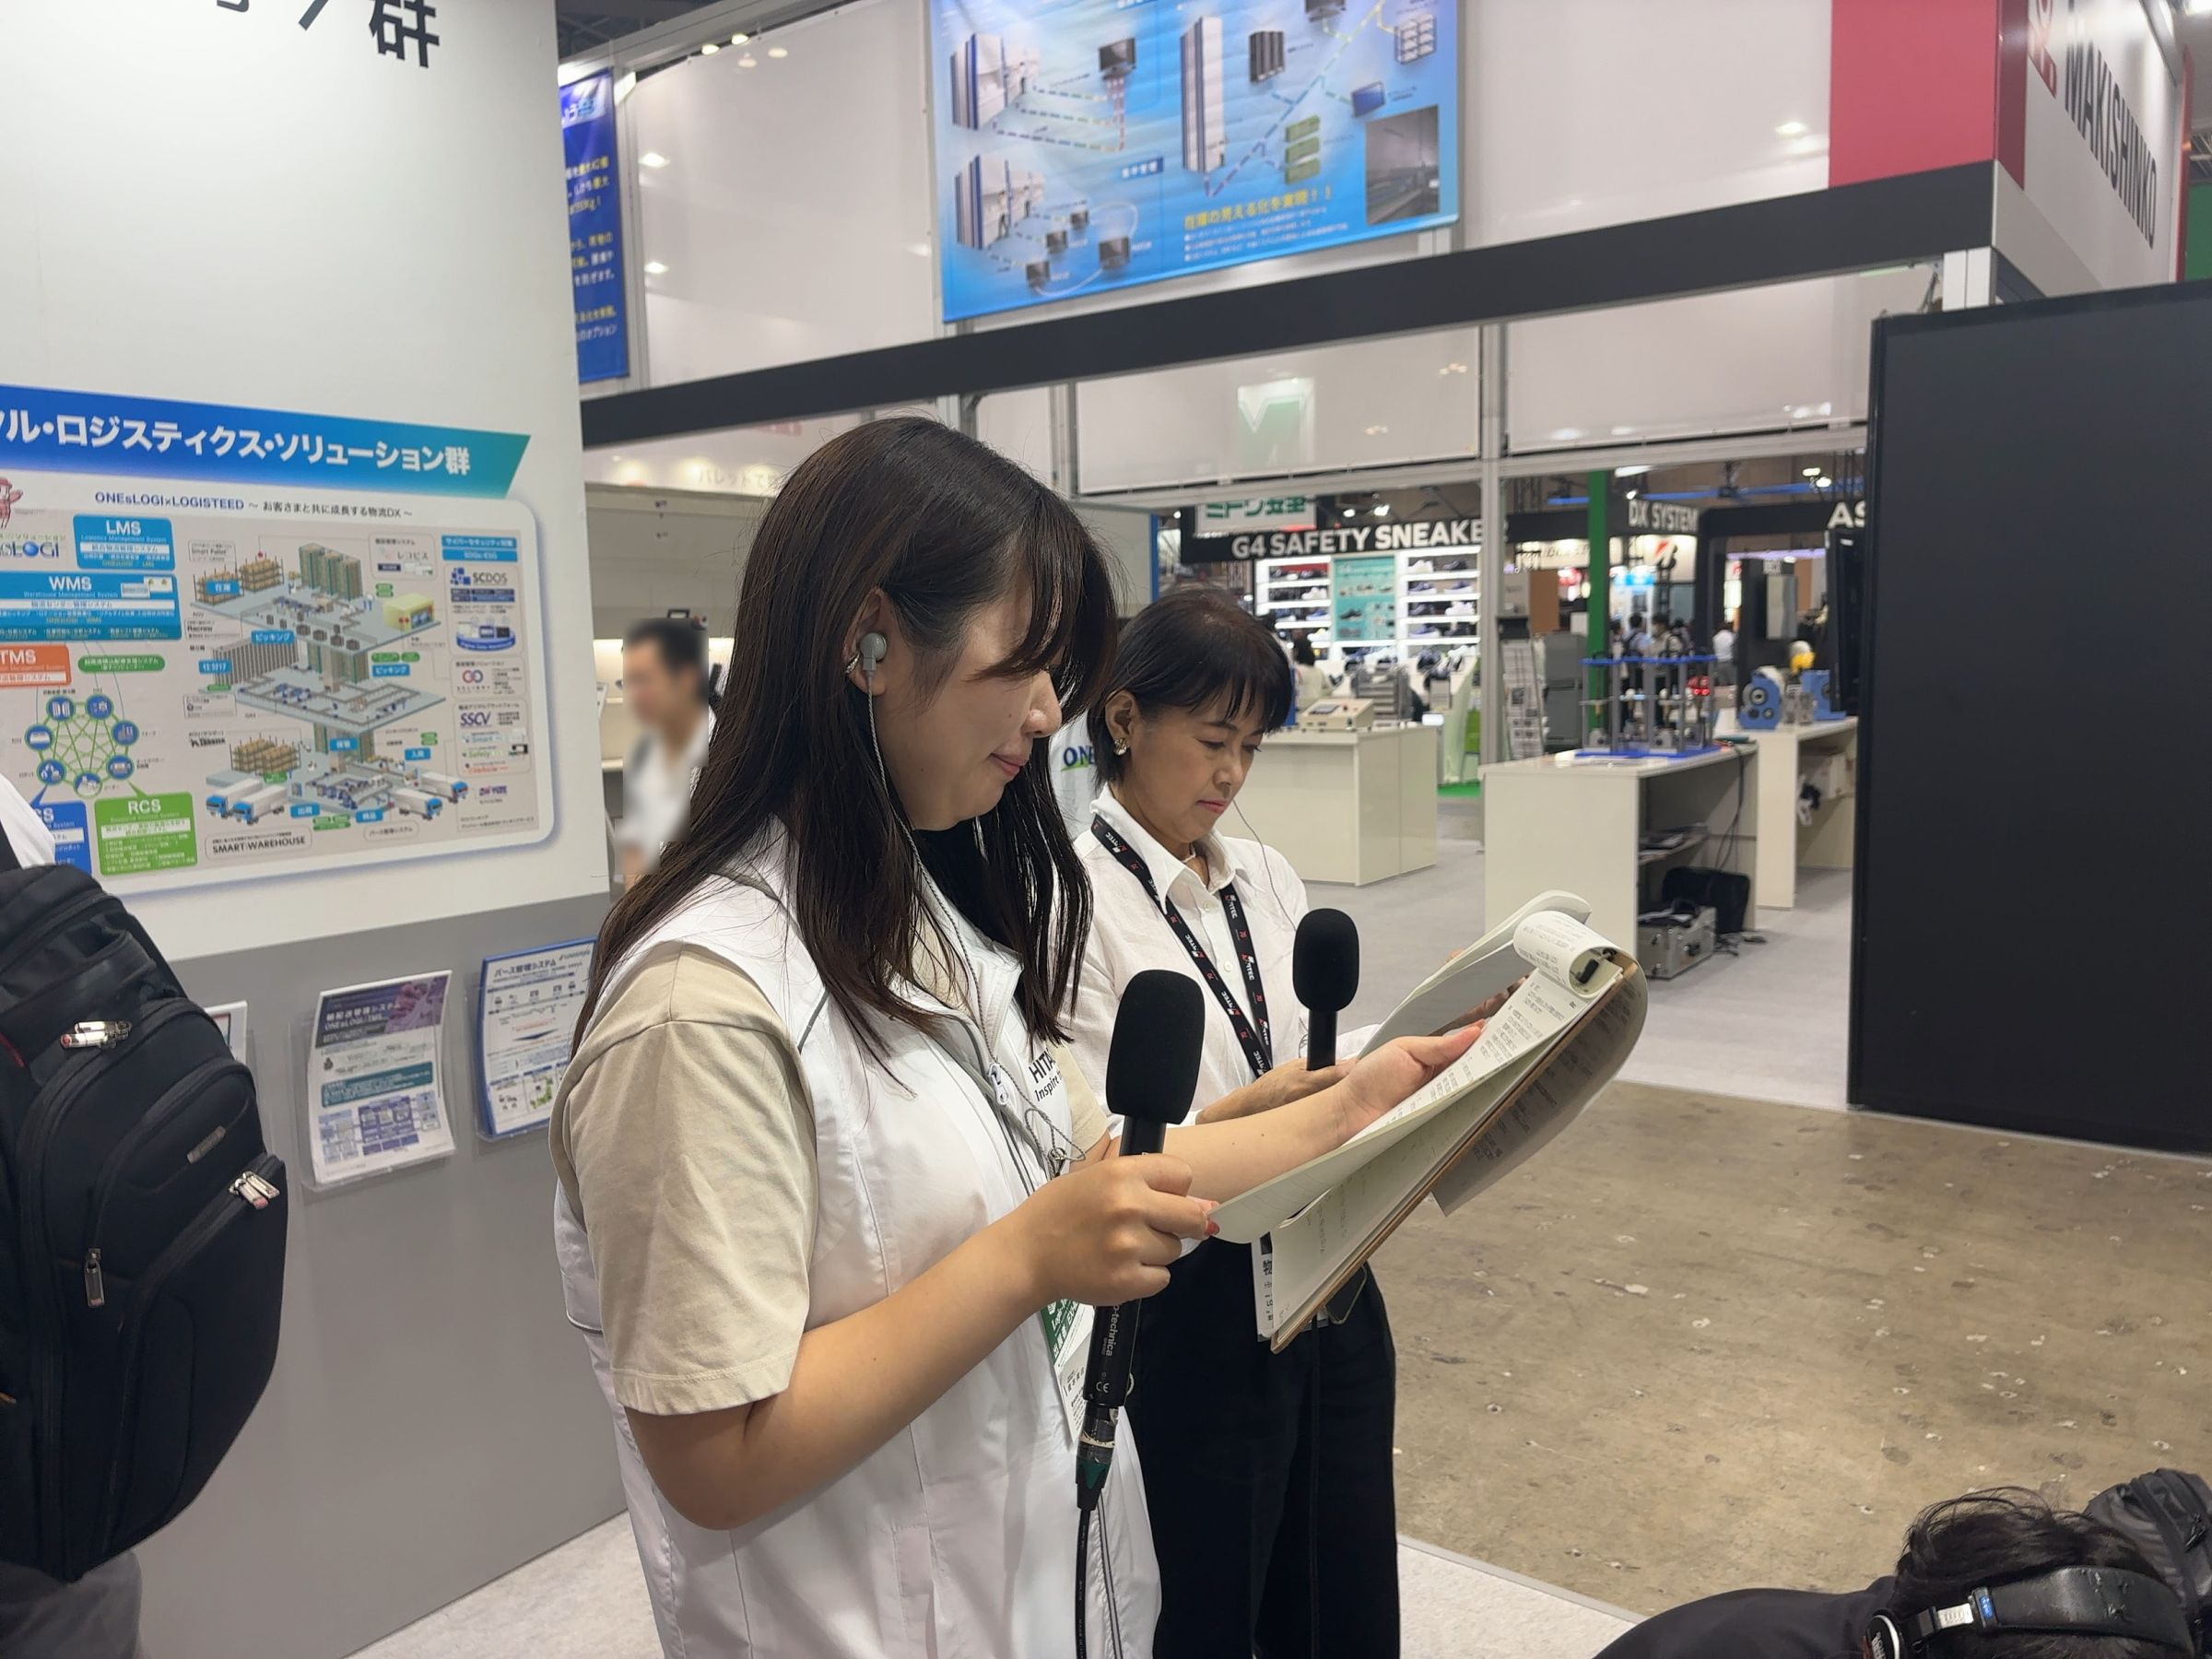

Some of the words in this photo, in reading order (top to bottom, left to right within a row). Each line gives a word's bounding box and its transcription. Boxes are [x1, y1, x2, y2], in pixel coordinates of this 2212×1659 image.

[0, 408, 471, 476] ル・ロジスティクス・ソリューション群
[1652, 503, 1699, 533] SYSTEM
[106, 520, 142, 535] LMS
[1231, 535, 1267, 559] G4
[1270, 526, 1371, 557] SAFETY
[1374, 518, 1486, 550] SNEAKE
[49, 576, 92, 592] WMS
[472, 572, 508, 583] SCDOS
[1, 649, 37, 665] TMS
[461, 712, 491, 726] SSCV
[127, 798, 161, 816] RCS
[212, 841, 245, 854] SMART
[248, 835, 306, 851] WAREHOUSE
[1034, 1074, 1060, 1102] Inspire
